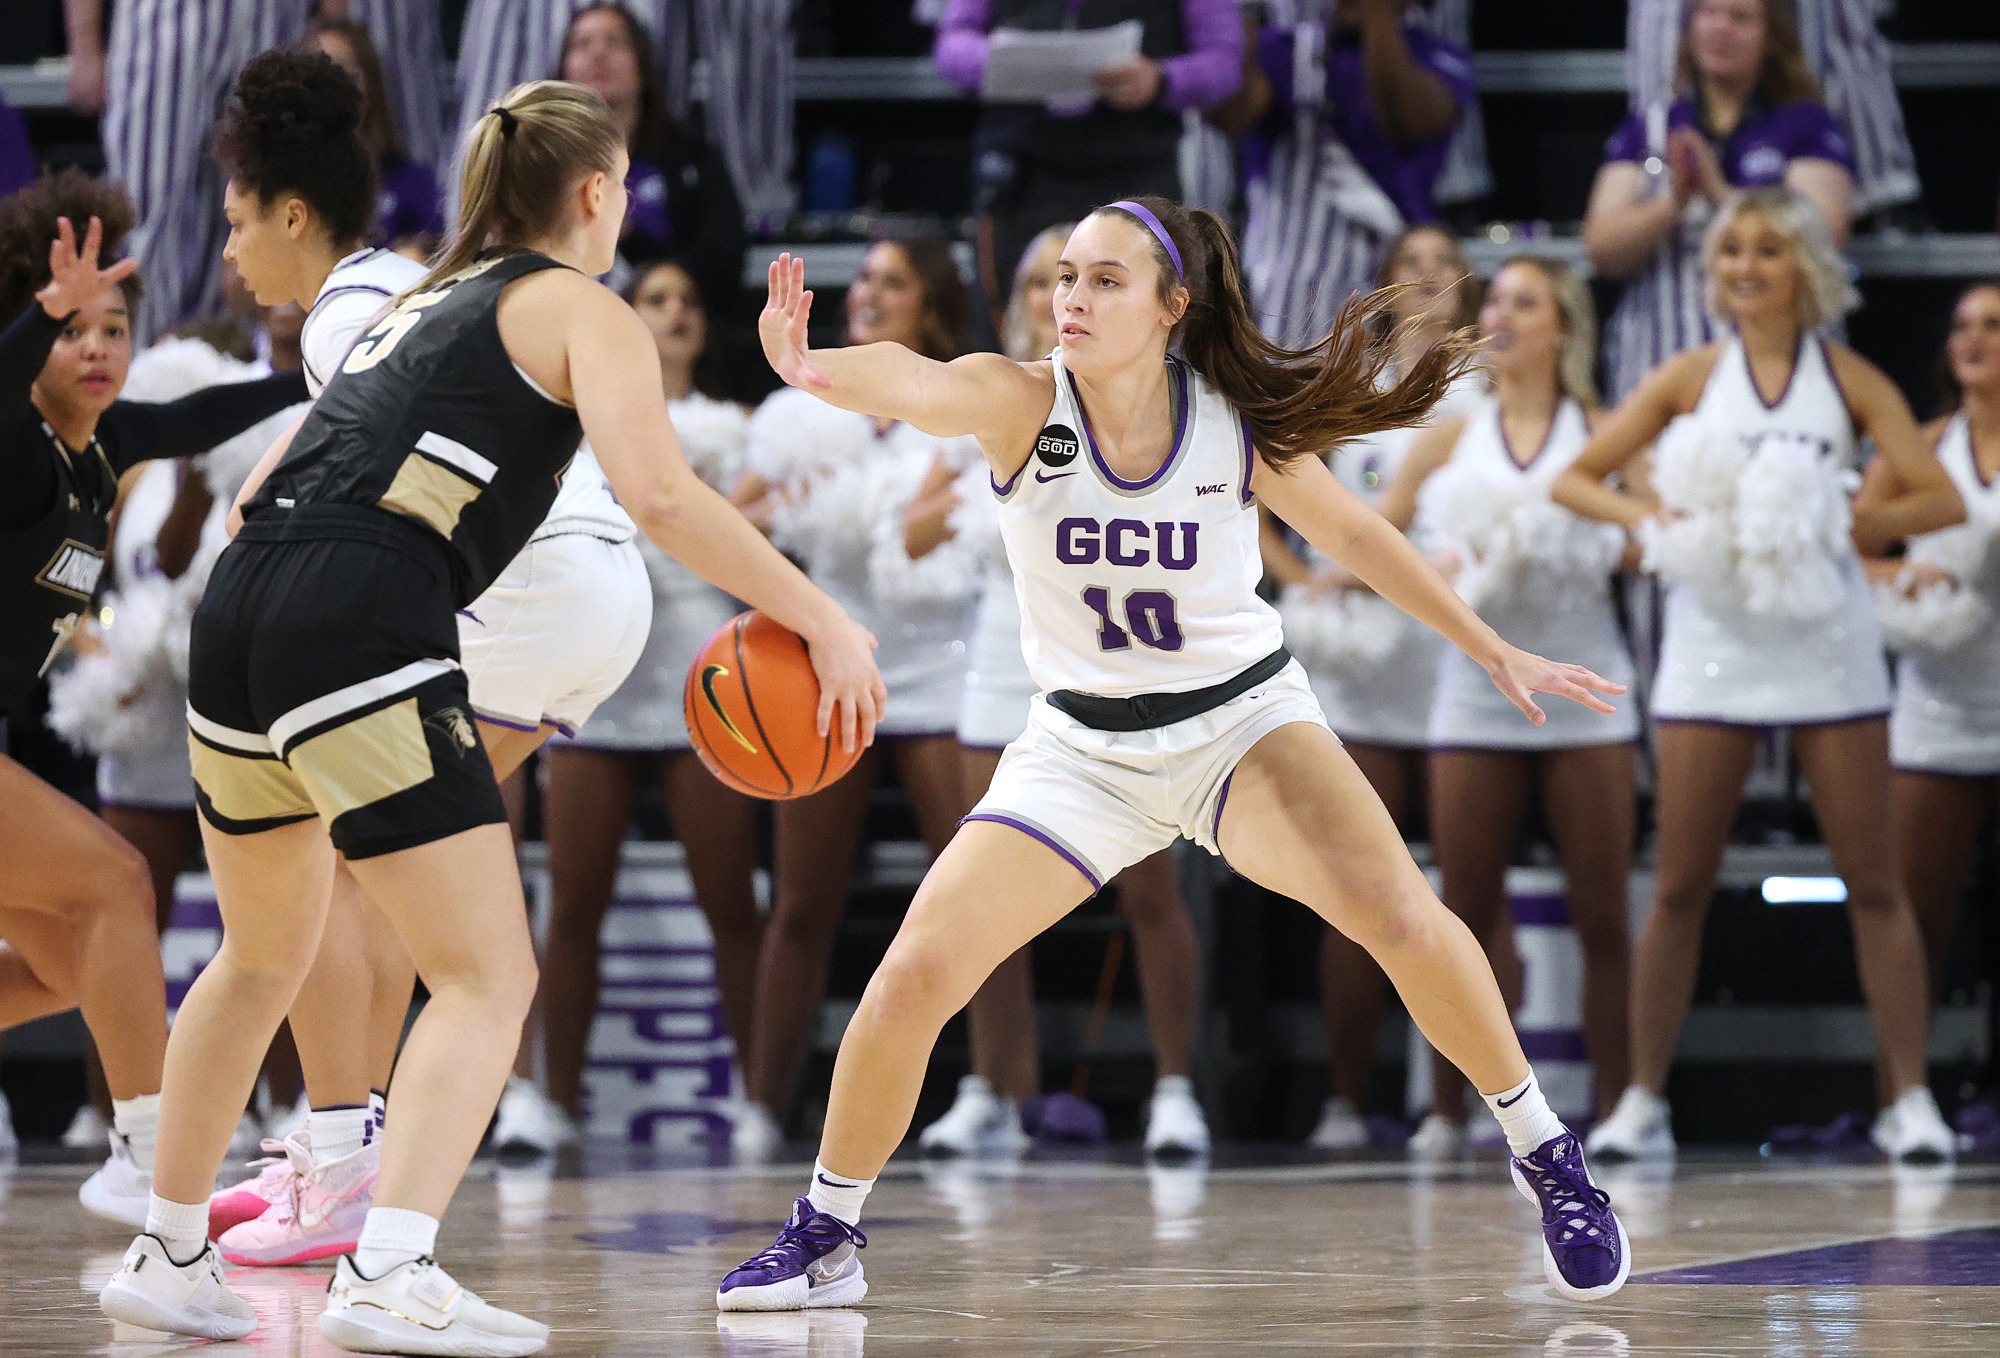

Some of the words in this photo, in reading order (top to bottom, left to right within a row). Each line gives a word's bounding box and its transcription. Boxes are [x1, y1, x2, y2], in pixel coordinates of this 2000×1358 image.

[1038, 440, 1076, 456] GOD
[1195, 483, 1228, 497] WAC
[1056, 517, 1200, 570] GCU
[1080, 584, 1186, 652] 10
